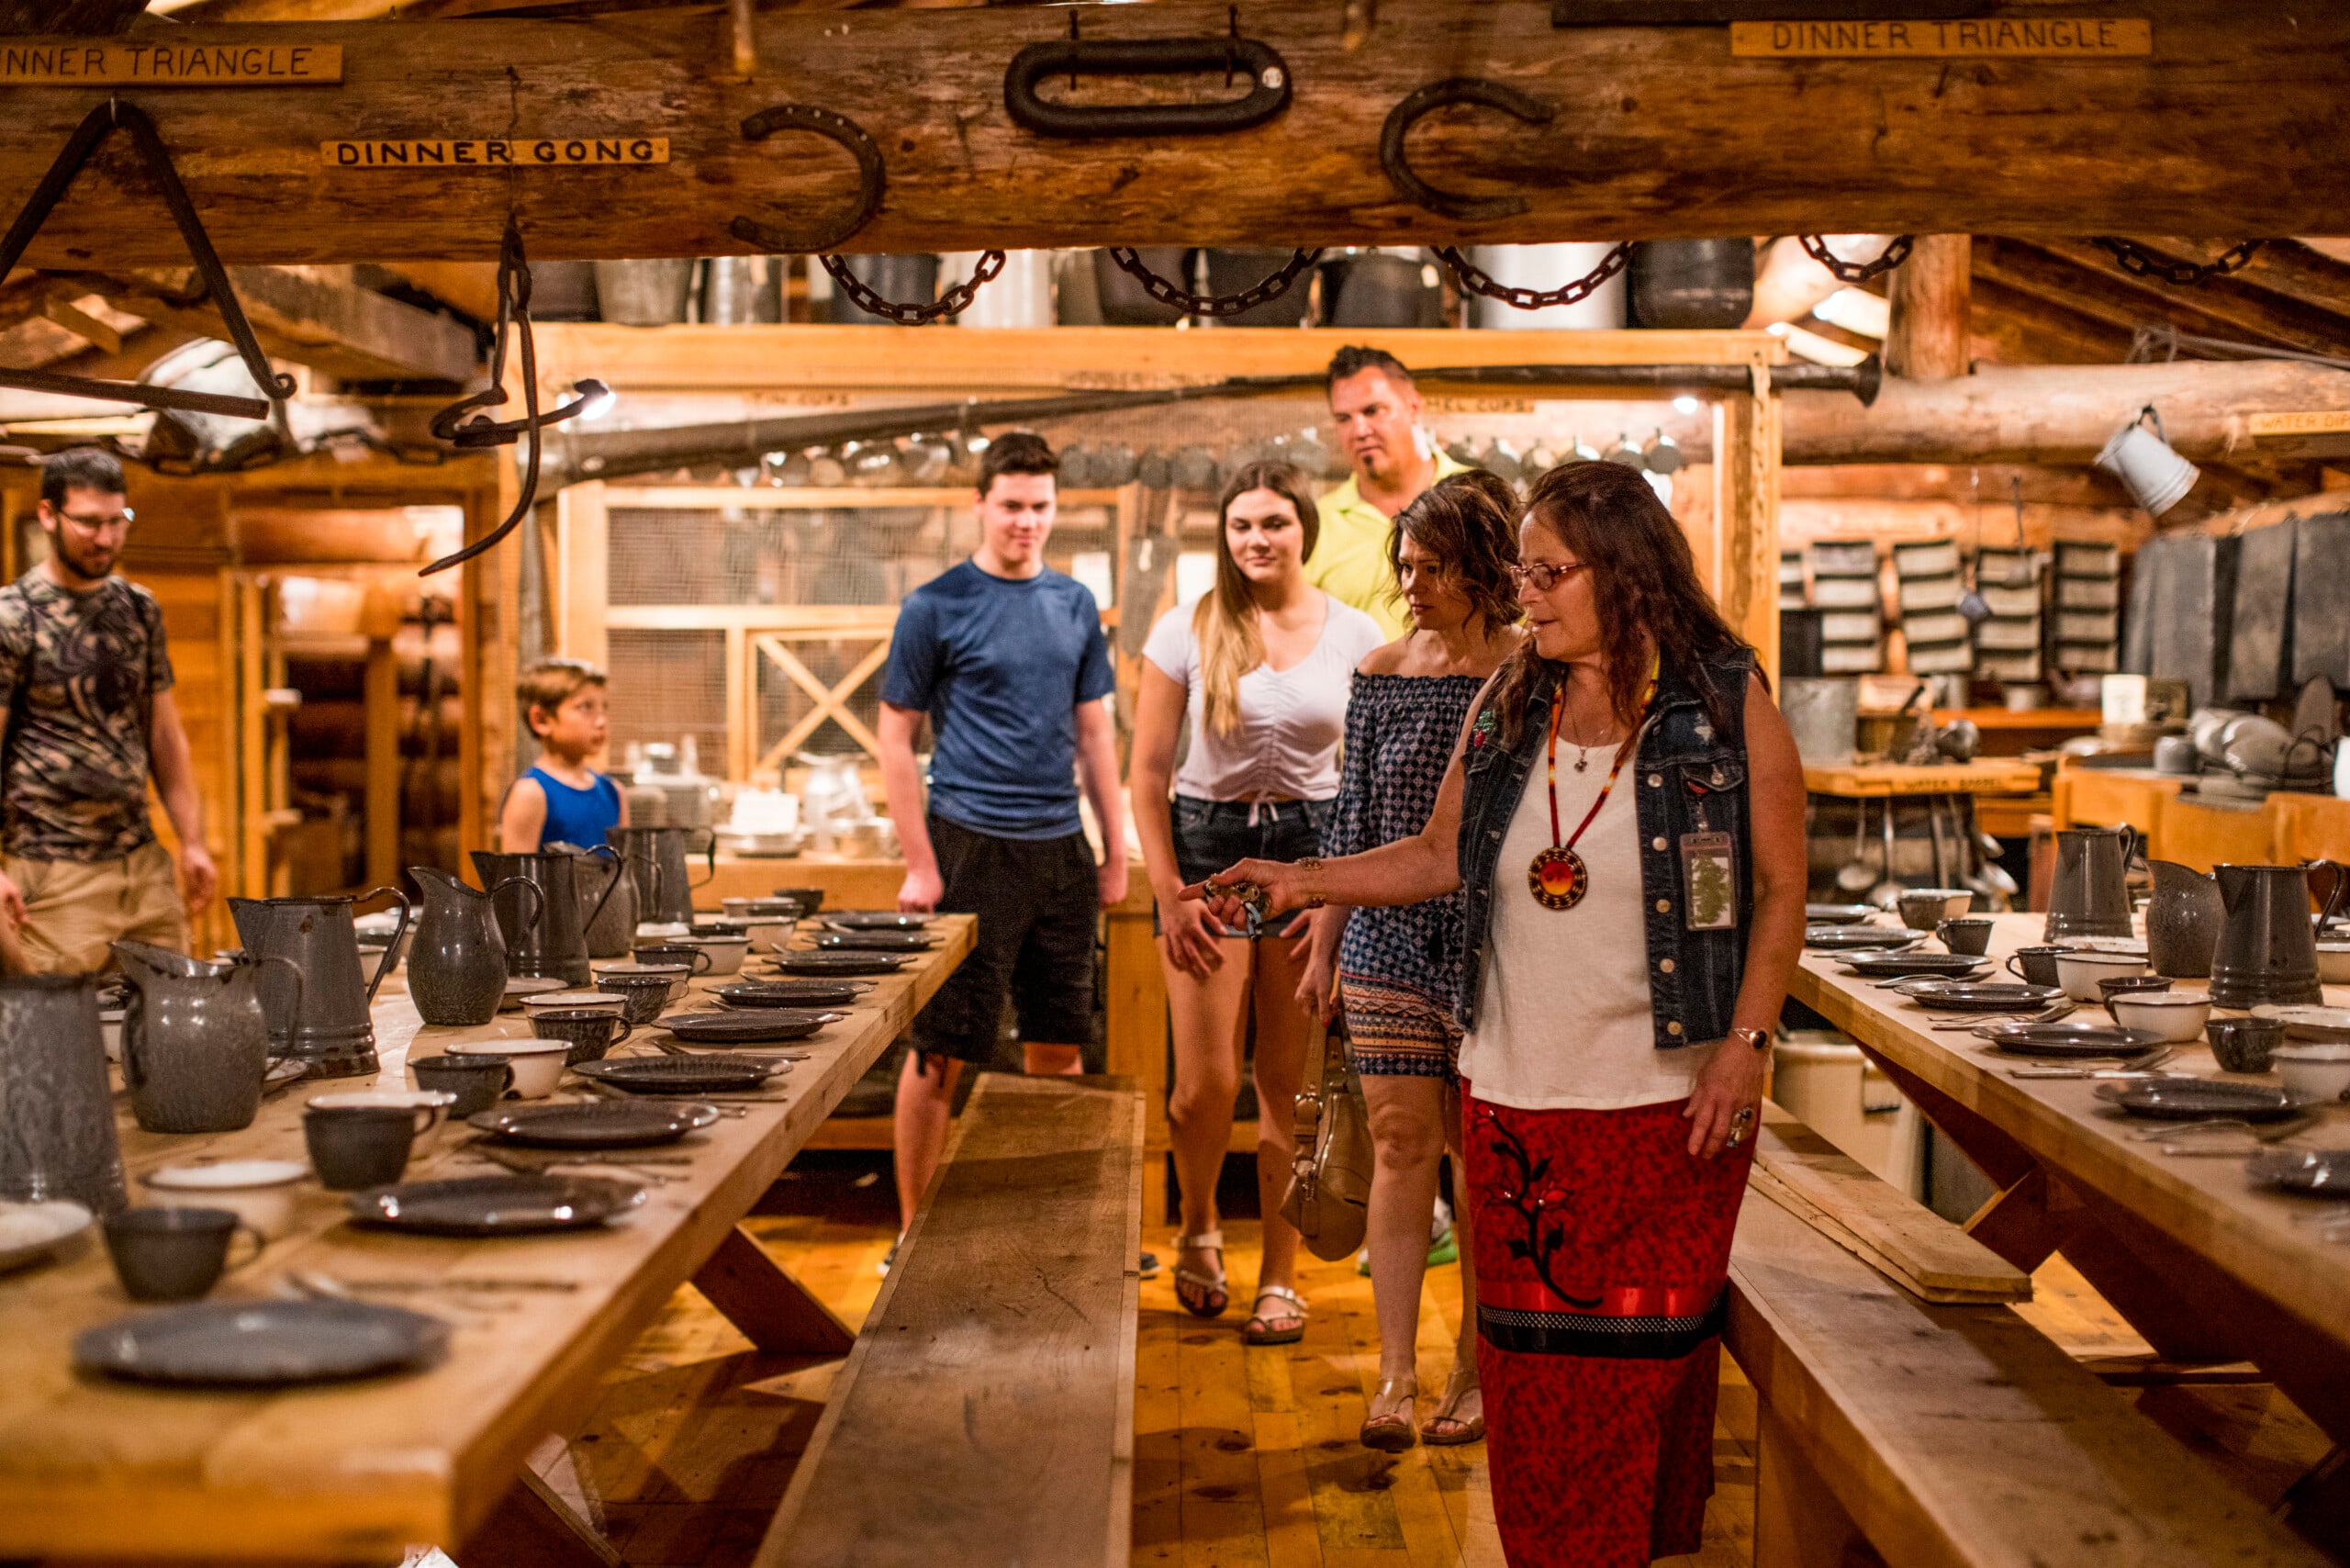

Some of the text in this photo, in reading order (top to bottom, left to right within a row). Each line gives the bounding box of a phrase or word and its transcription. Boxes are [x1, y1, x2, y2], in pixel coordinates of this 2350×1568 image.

[1773, 20, 2118, 50] DINNER TRIANGLE
[0, 48, 312, 75] NNER TRIANGLE
[337, 140, 654, 165] DINNER GONG
[2261, 415, 2317, 430] WATER
